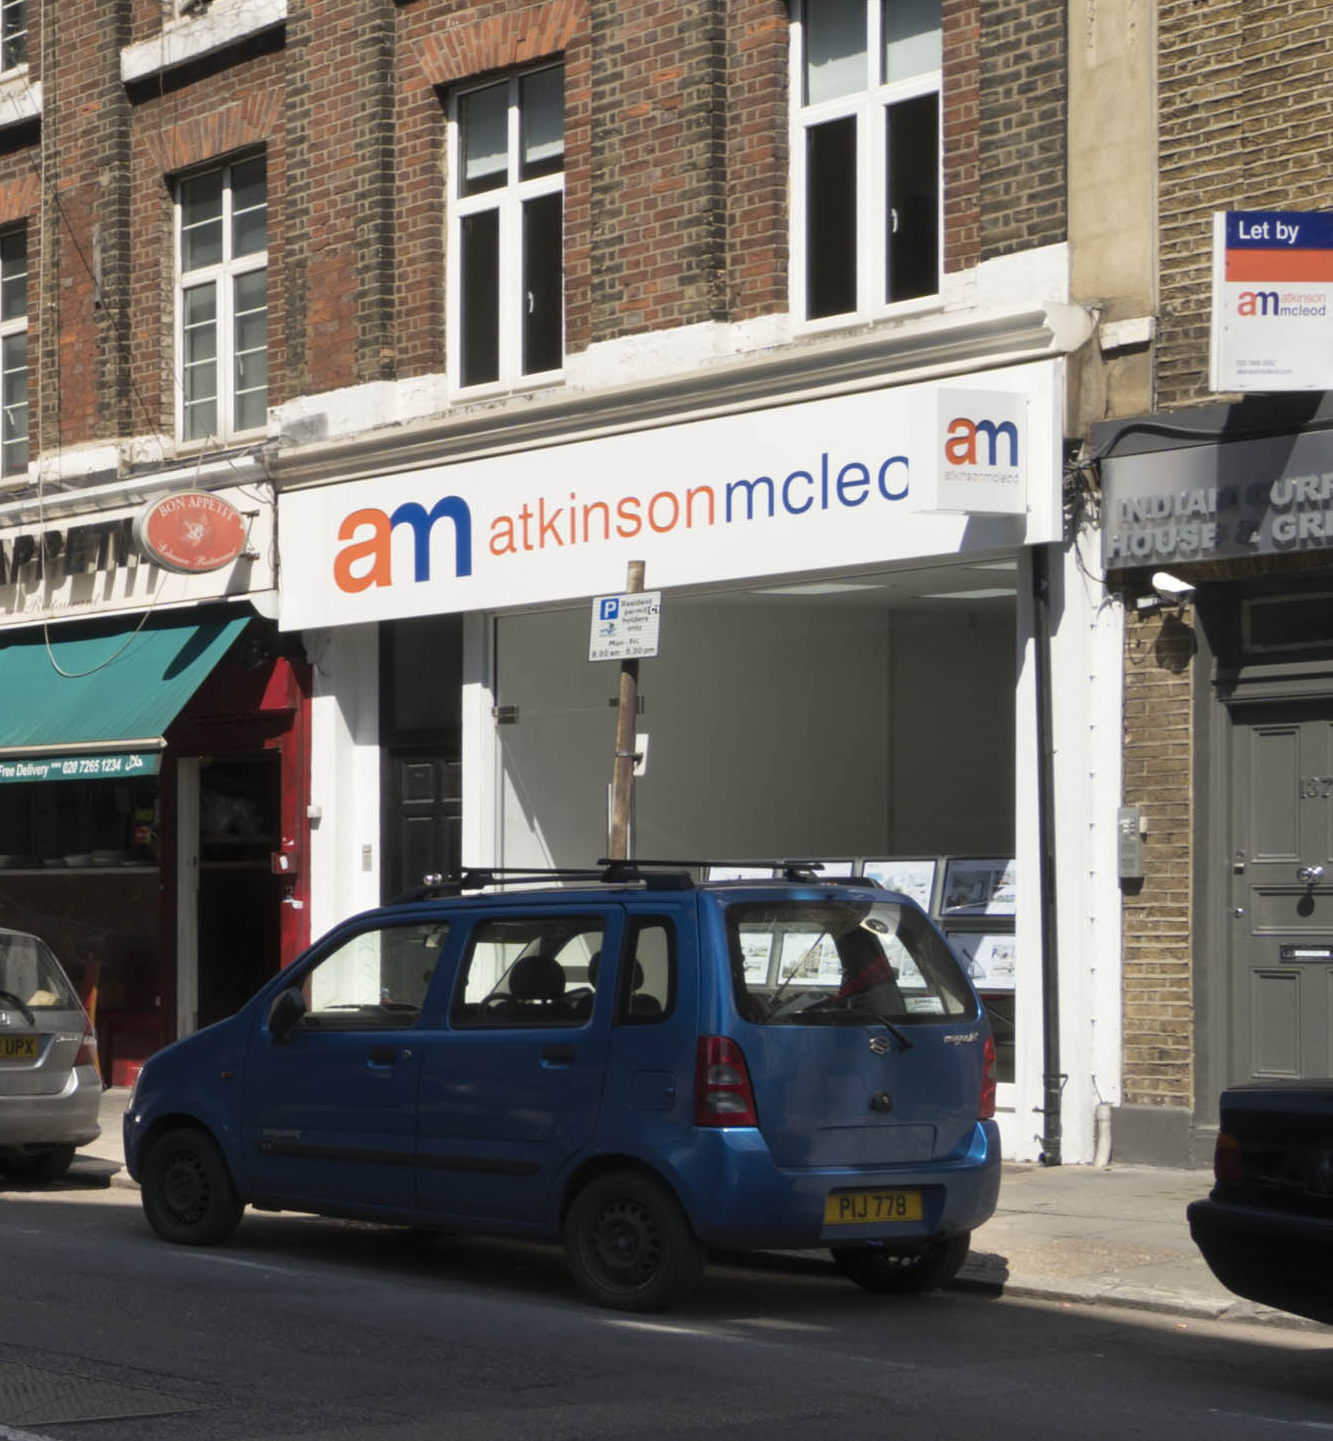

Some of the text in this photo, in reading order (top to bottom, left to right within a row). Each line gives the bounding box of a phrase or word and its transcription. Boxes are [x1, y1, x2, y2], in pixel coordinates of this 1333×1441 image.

[1238, 220, 1299, 244] Let by
[1237, 290, 1280, 317] am
[1280, 292, 1326, 304] atkinson
[1280, 304, 1326, 316] mcleod
[944, 417, 1019, 467] am
[159, 496, 234, 521] BON APPETIT
[333, 452, 909, 594] am atkinsonmcleo
[1108, 522, 1222, 559] HOUSE
[604, 601, 617, 619] P
[621, 599, 653, 607] Resident
[624, 606, 647, 616] permit
[608, 639, 623, 647] Mon
[16, 762, 49, 778] Delivery
[63, 761, 77, 774] 020
[79, 760, 99, 773] 7265
[101, 759, 121, 772] 1234
[5, 1038, 35, 1055] UPX
[874, 1194, 907, 1218] 778
